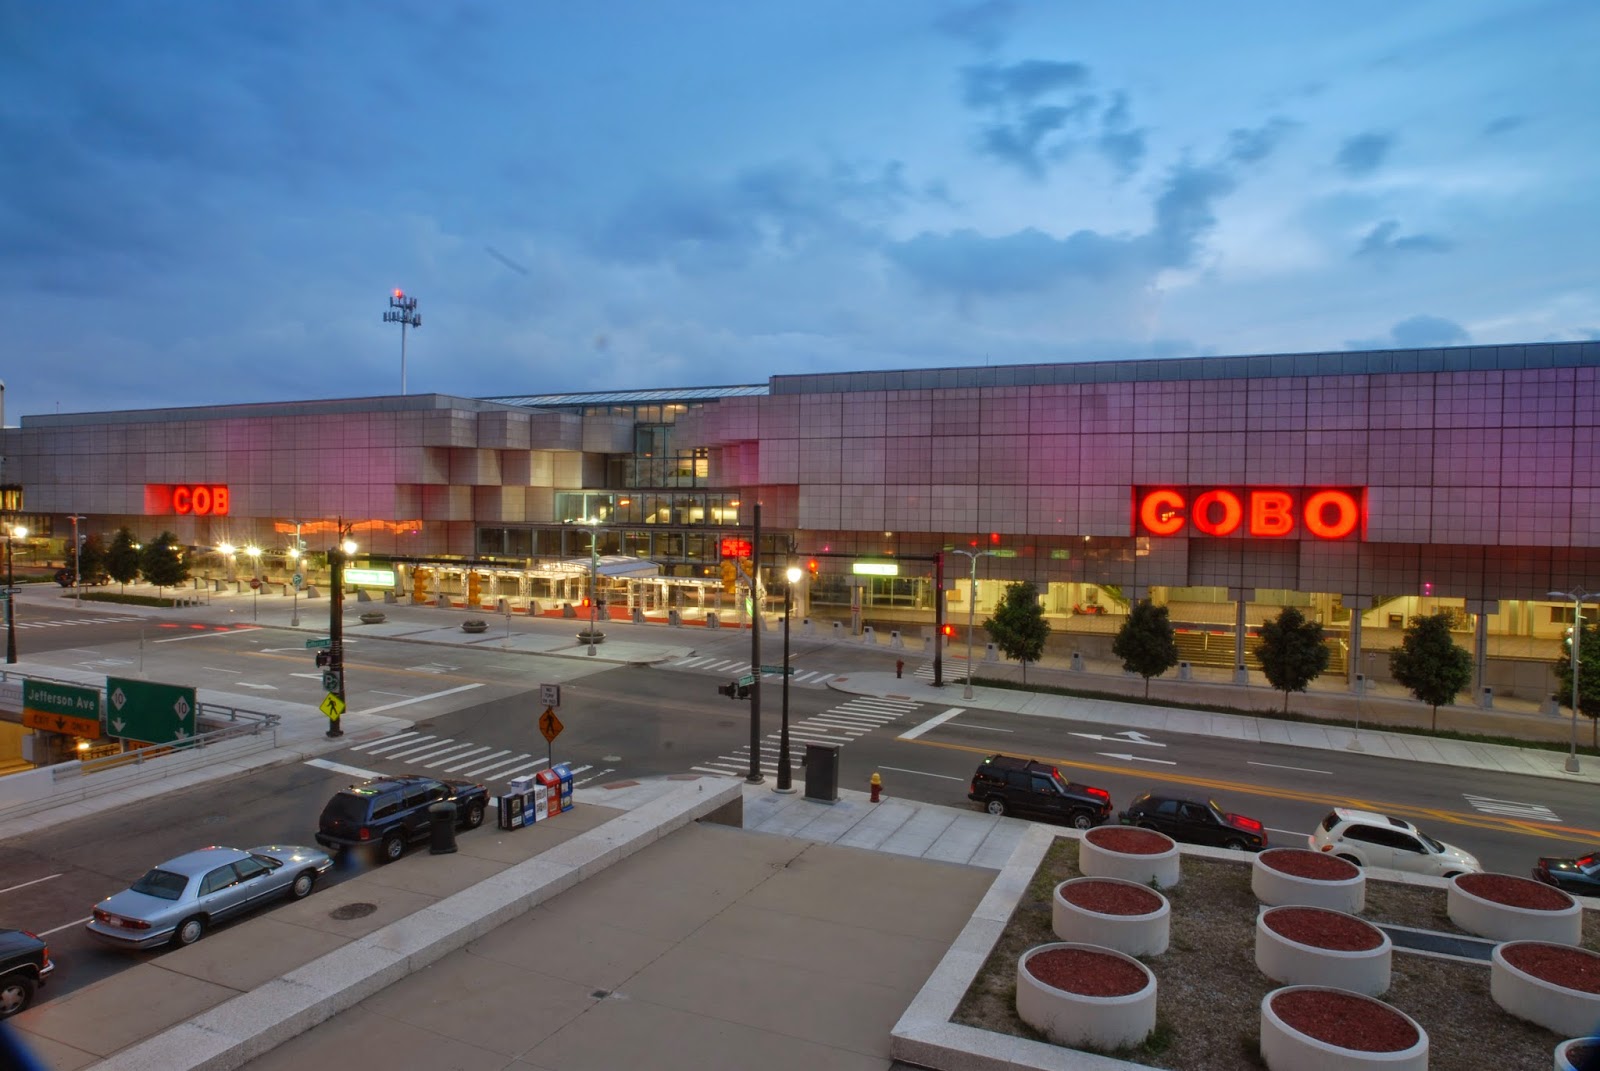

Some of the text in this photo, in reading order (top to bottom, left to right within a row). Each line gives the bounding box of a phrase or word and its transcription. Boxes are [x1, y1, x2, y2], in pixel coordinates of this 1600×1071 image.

[1141, 489, 1360, 539] COBO
[28, 689, 95, 711] Jefferson Ave
[114, 692, 123, 705] 10
[176, 702, 187, 714] 10
